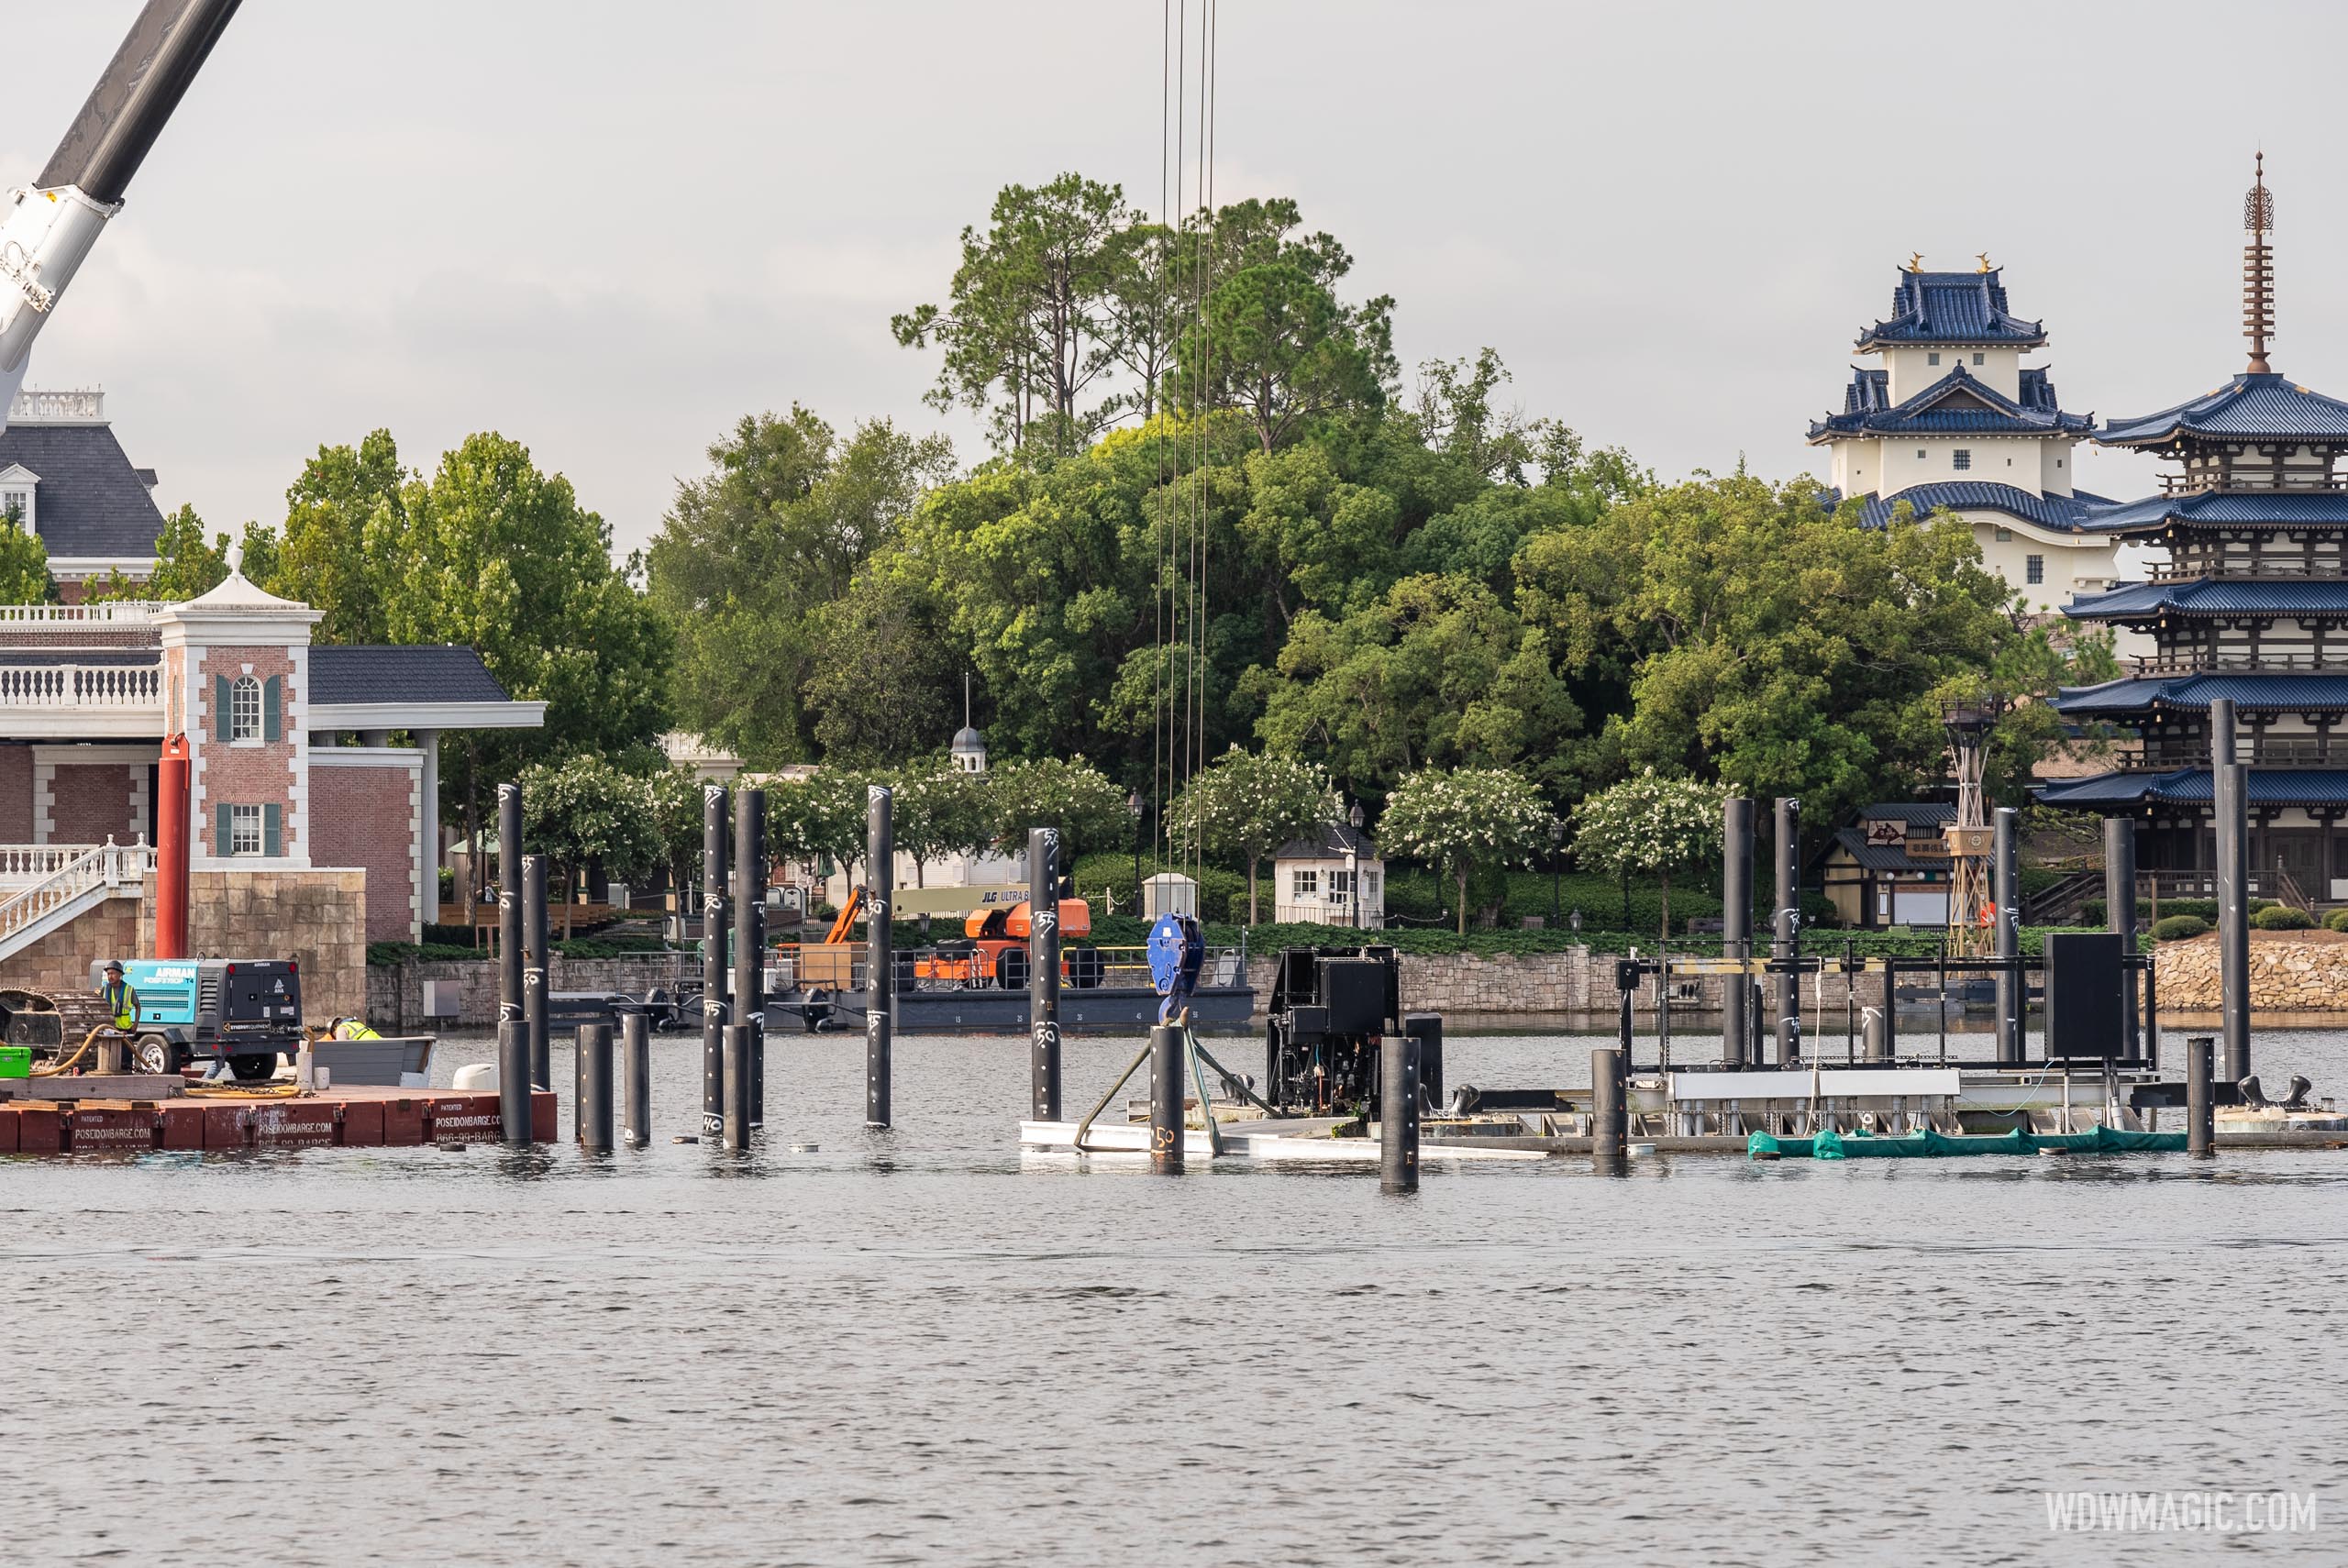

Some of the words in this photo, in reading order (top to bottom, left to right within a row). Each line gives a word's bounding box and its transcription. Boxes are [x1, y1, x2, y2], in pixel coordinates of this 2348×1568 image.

[982, 892, 997, 902] JLG
[1002, 890, 1023, 901] ULTRA
[156, 966, 195, 978] AIRMAN
[1036, 1028, 1055, 1045] 50
[259, 1122, 332, 1134] POSEIDONBARGE.COM
[703, 1116, 722, 1131] 40
[75, 1128, 150, 1140] POSEIDONBARGE.COM
[1156, 1127, 1175, 1147] 50
